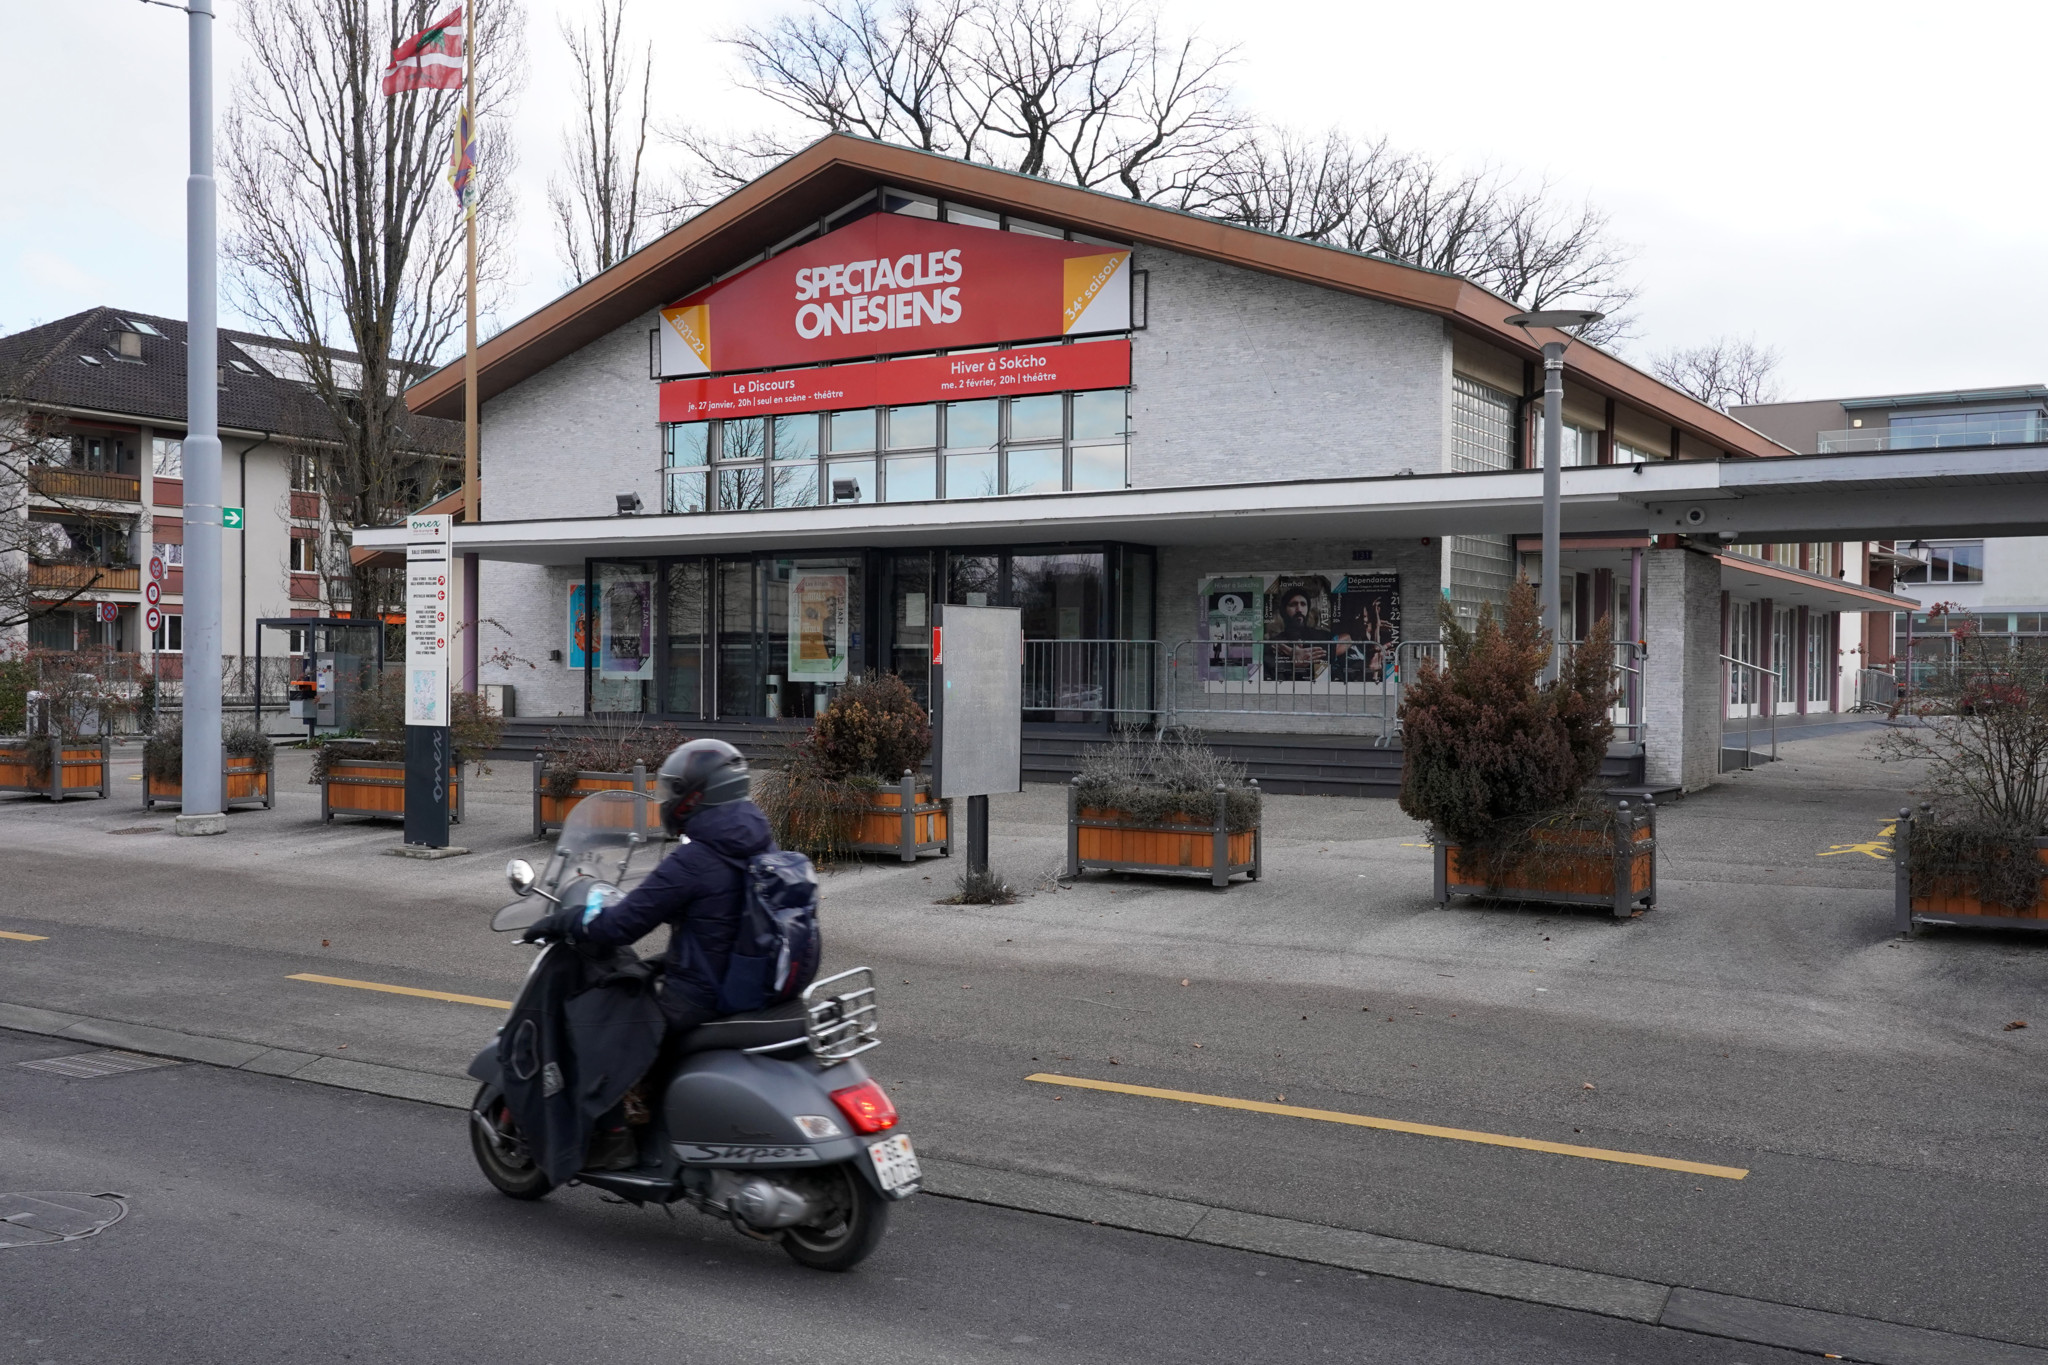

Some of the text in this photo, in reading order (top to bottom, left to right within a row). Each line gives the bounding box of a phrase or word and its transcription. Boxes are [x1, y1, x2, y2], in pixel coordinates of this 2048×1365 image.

[795, 248, 963, 301] SPECTACLES
[1084, 257, 1119, 299] saison
[795, 286, 962, 340] ONÉSIENS
[951, 354, 1047, 375] Hiver à Sokcho
[733, 379, 795, 394] Le Discours
[941, 381, 957, 390] me.
[958, 379, 965, 388] 2
[965, 377, 997, 387] février,
[999, 375, 1016, 385] 20h
[1022, 371, 1057, 383] théâtre
[687, 402, 697, 412] je.
[698, 401, 707, 410] 27
[708, 400, 736, 412] janvier,
[737, 398, 752, 407] 20h
[757, 395, 772, 405] seul
[773, 396, 783, 404] en
[784, 392, 806, 403] scène
[813, 389, 844, 400] théâtre
[412, 520, 441, 530] onex
[1348, 576, 1396, 585] Dépendances
[1255, 599, 1261, 607] 2
[1390, 596, 1400, 605] 21
[1390, 612, 1400, 620] 22
[1391, 623, 1400, 647] JAN.
[432, 729, 444, 803] onex
[687, 1145, 808, 1164] Super
